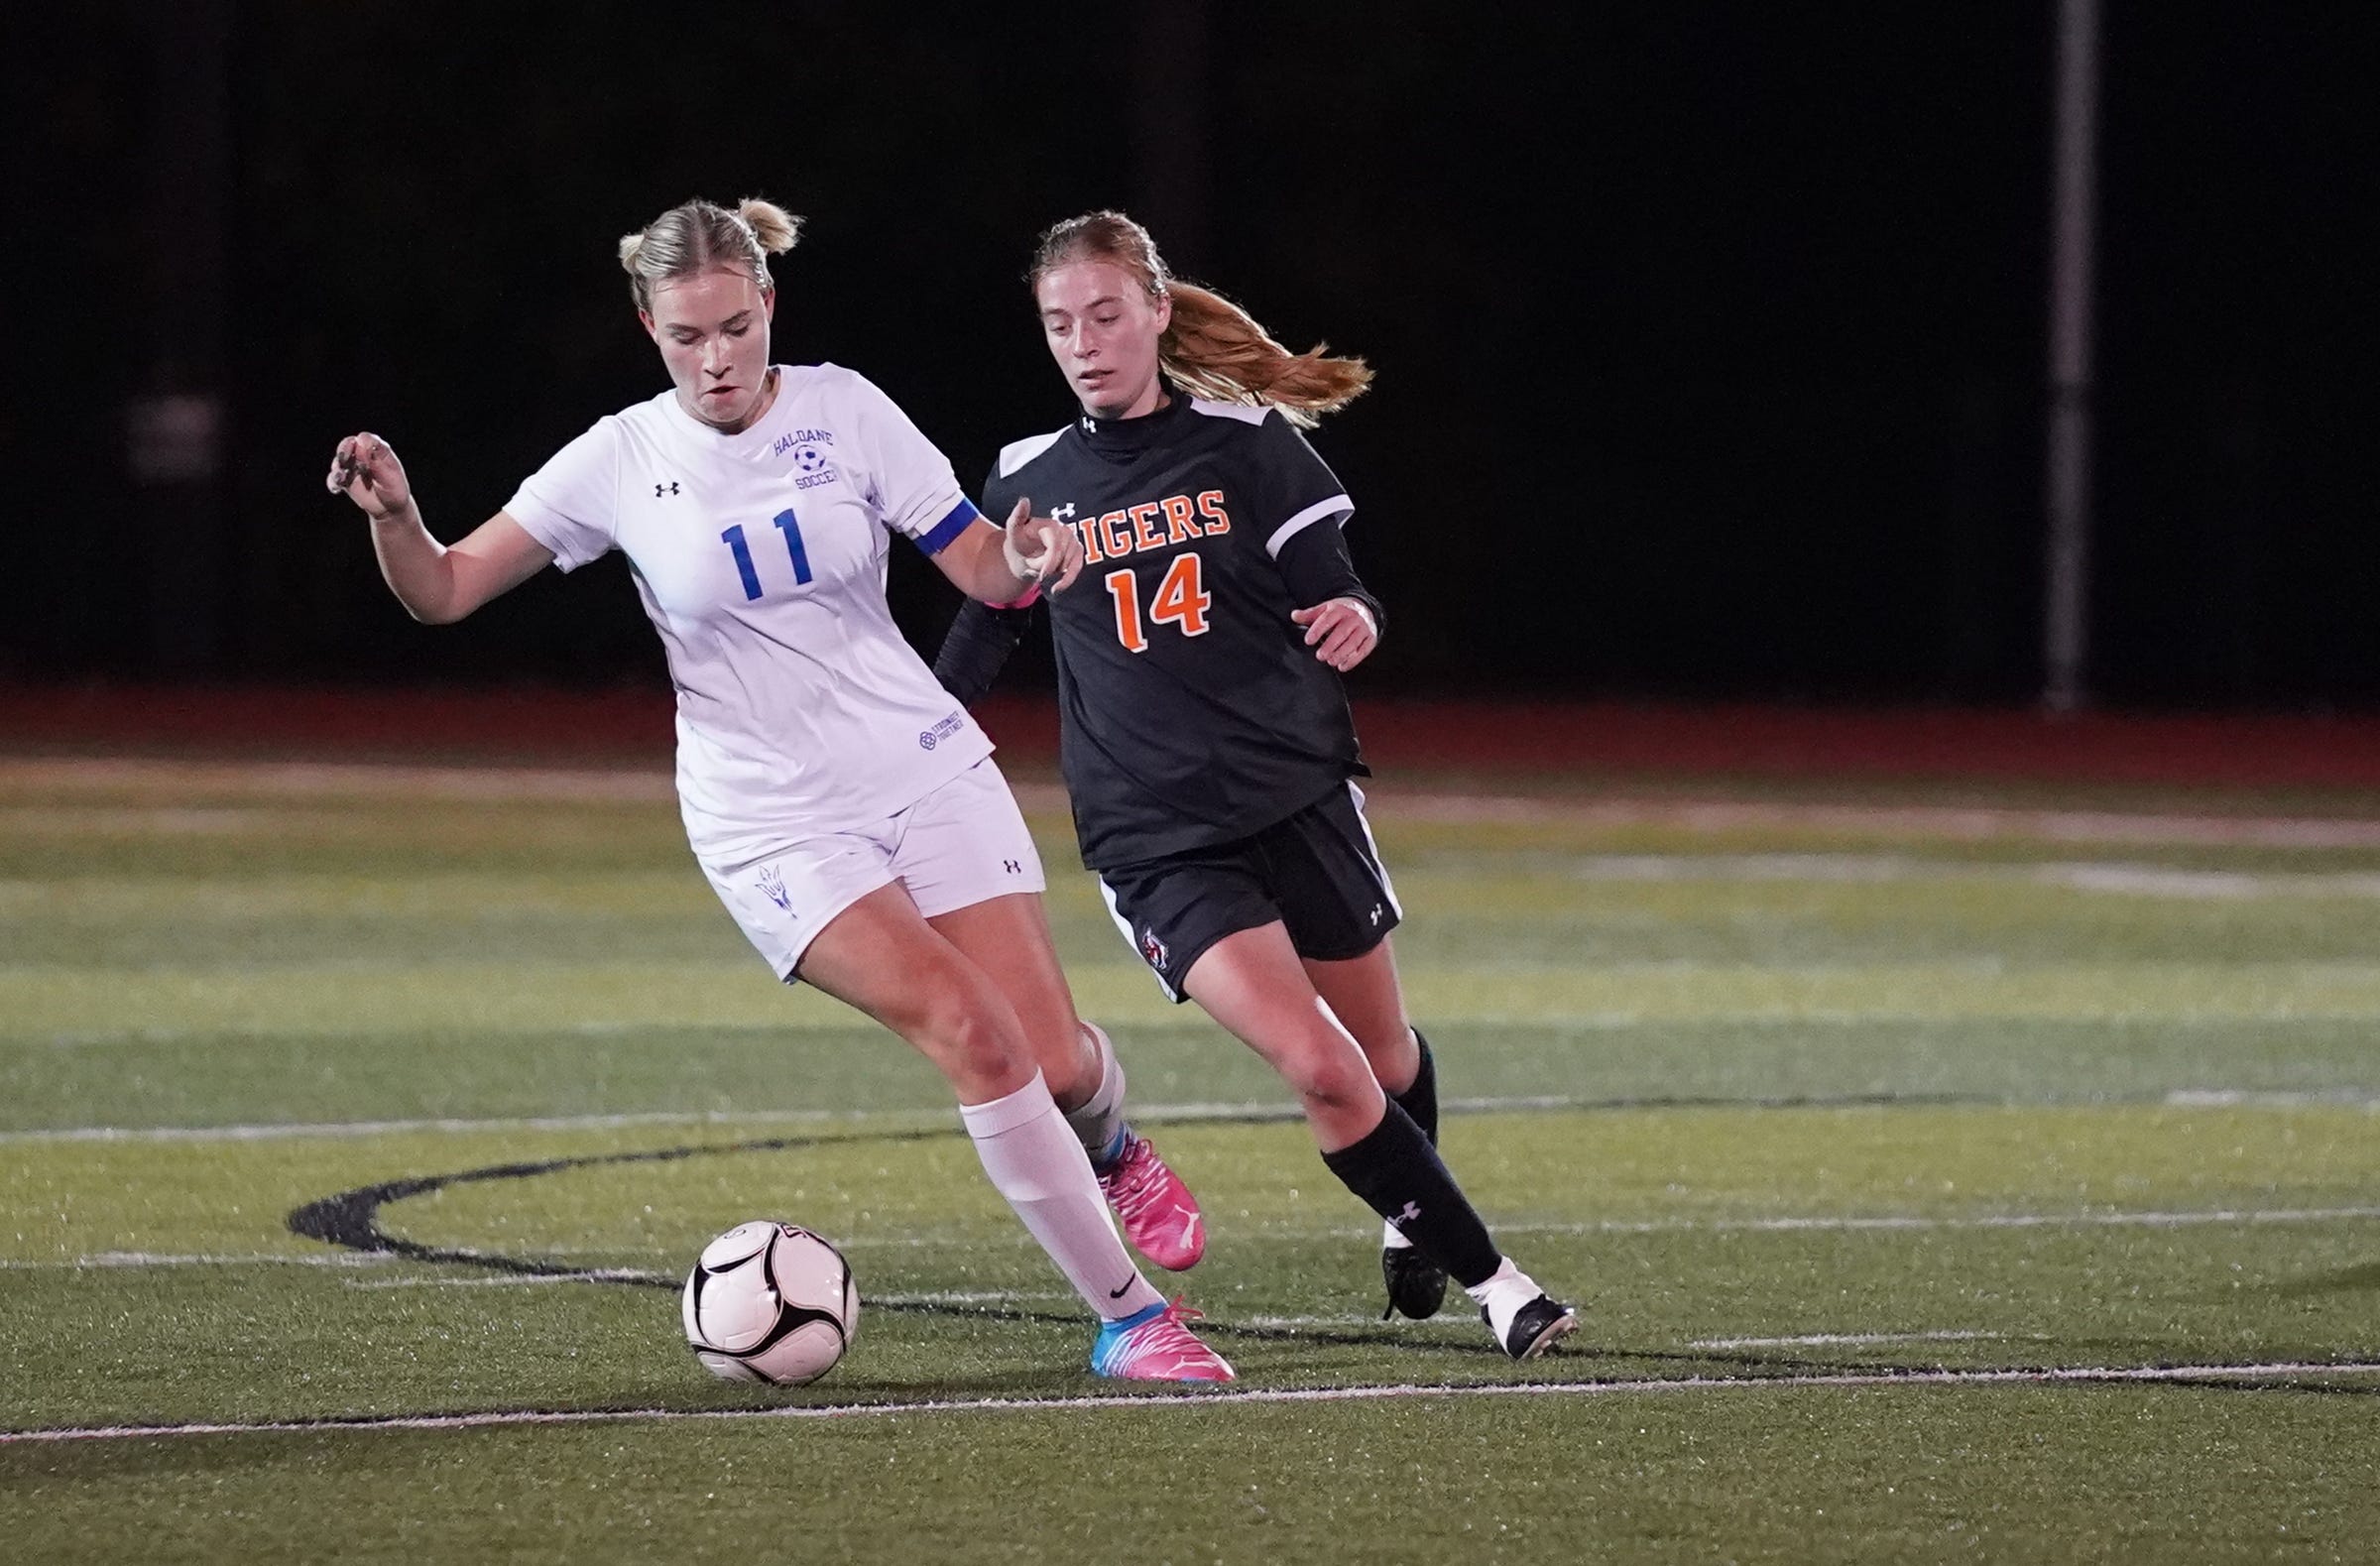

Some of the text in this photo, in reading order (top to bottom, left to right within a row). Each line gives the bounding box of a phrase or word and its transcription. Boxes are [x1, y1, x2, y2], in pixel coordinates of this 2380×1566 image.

[774, 428, 834, 457] HALDANE
[721, 508, 813, 601] 11
[1065, 490, 1232, 565] IGERS
[1105, 551, 1212, 654] 14
